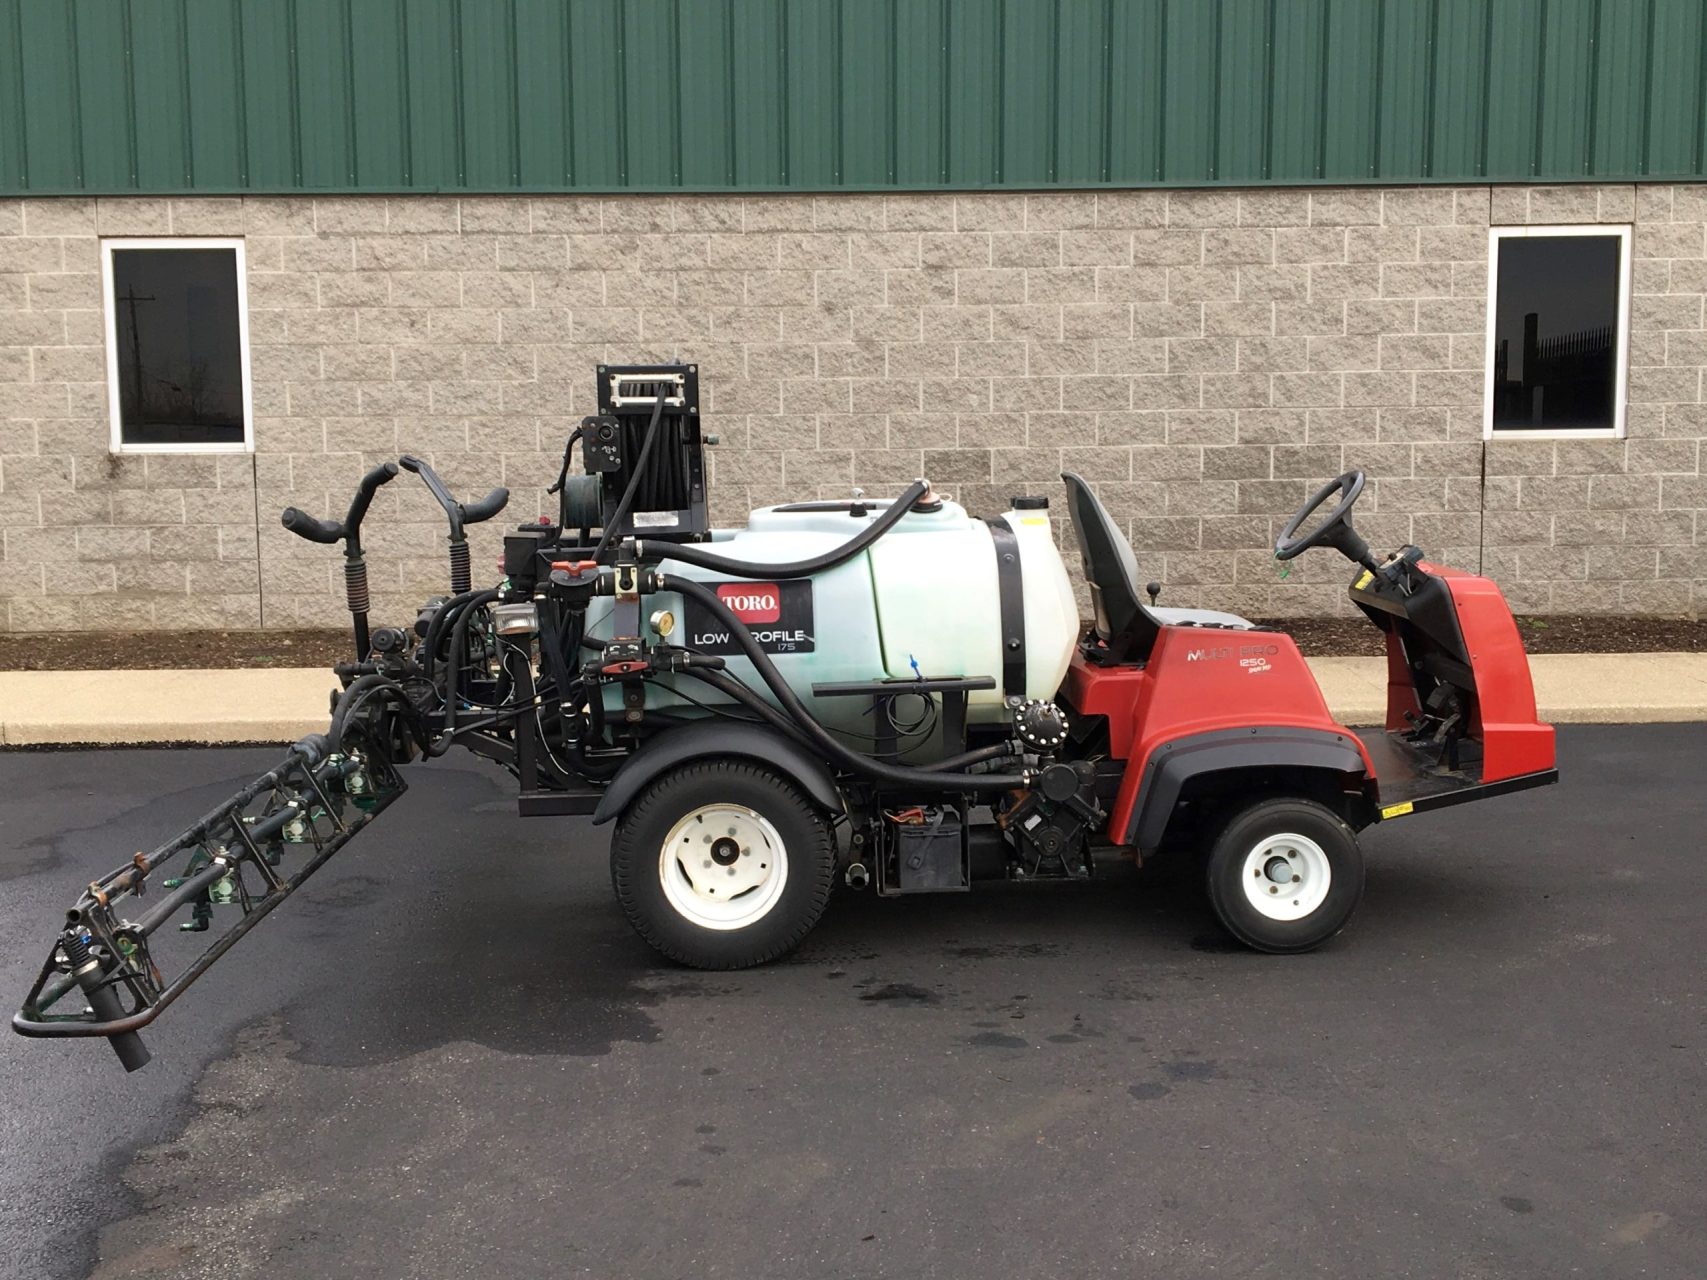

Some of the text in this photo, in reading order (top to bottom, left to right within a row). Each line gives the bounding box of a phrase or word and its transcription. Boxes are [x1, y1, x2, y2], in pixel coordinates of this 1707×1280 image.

[722, 594, 775, 611] TORO
[694, 630, 804, 645] LOW ROFILE
[777, 643, 796, 651] 175
[1240, 657, 1266, 667] 1250
